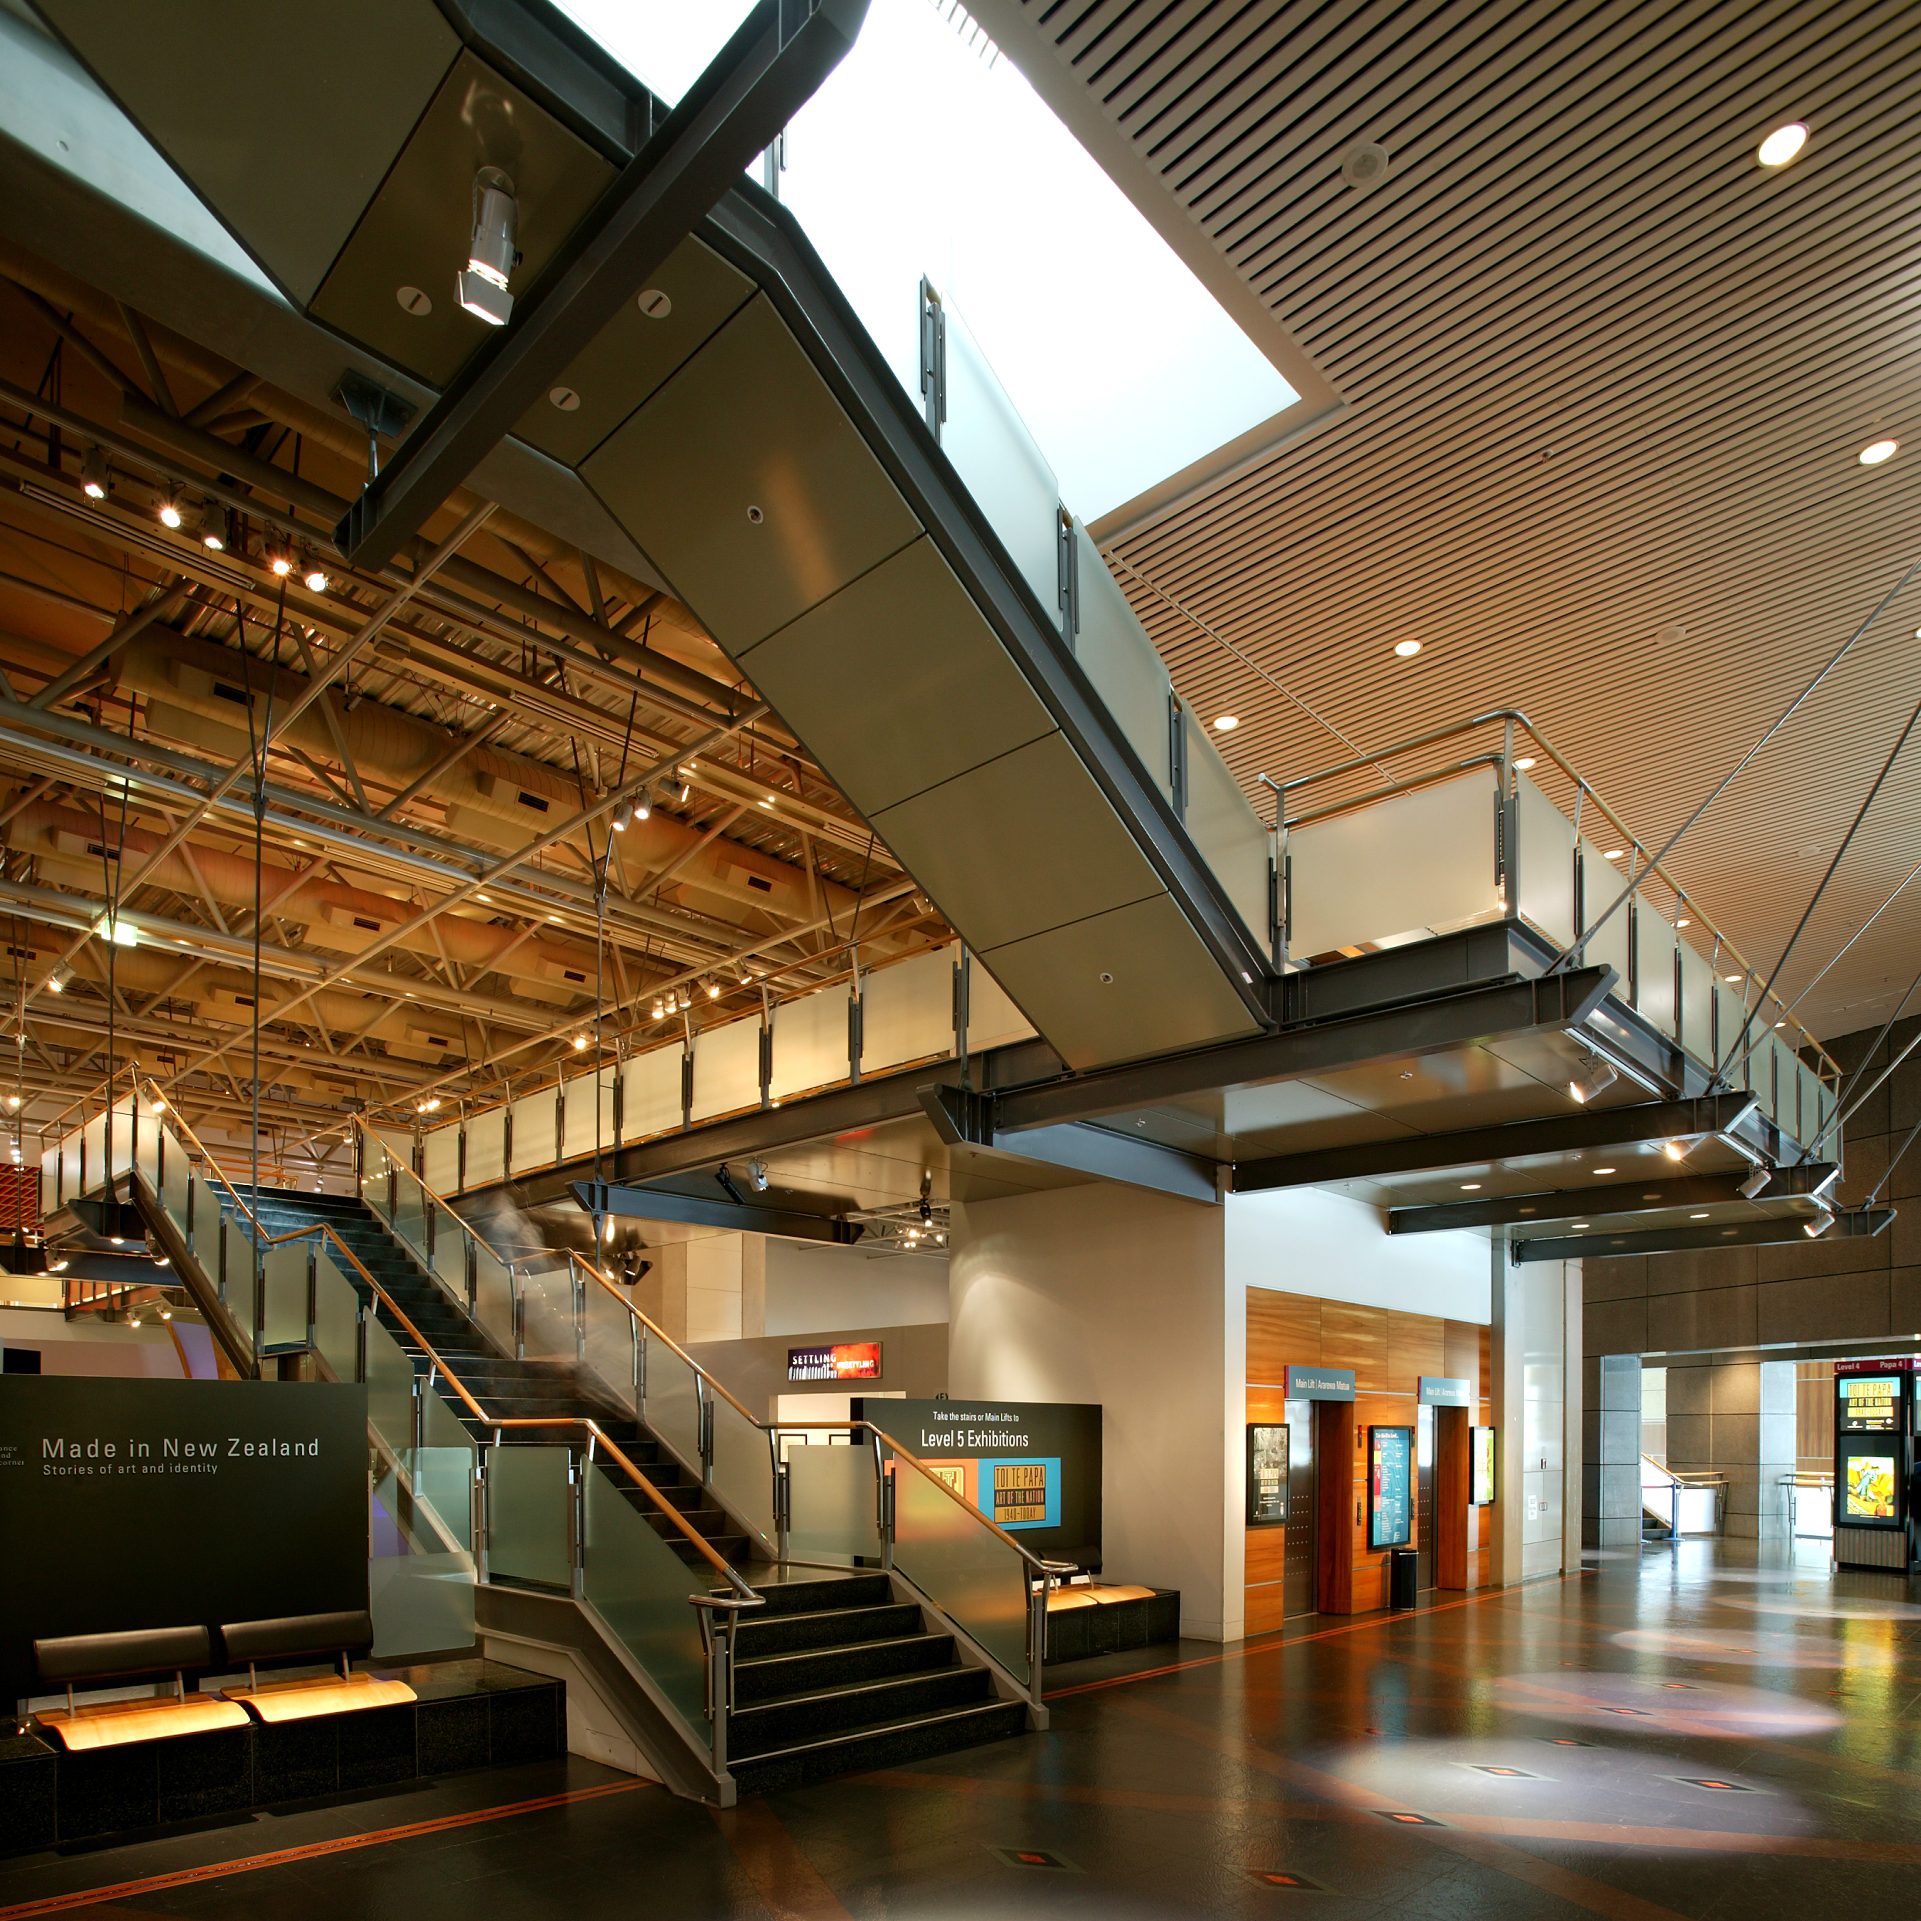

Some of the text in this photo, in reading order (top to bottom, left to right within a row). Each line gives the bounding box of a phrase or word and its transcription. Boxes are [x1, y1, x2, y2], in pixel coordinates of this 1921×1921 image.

[792, 1354, 837, 1365] SETTLING
[1880, 1361, 1897, 1370] Papa
[1295, 1378, 1307, 1389] Main
[933, 1411, 1020, 1423] Take the stairs or Main Lifts to
[921, 1429, 1029, 1447] Level 5 Exhibitions
[42, 1438, 319, 1459] Made in New Zealand
[43, 1463, 218, 1475] Stories of art and identity
[996, 1467, 1044, 1488] TOI TE PAPA
[996, 1491, 1006, 1505] ART
[1007, 1491, 1014, 1505] OF
[1015, 1490, 1025, 1504] THE
